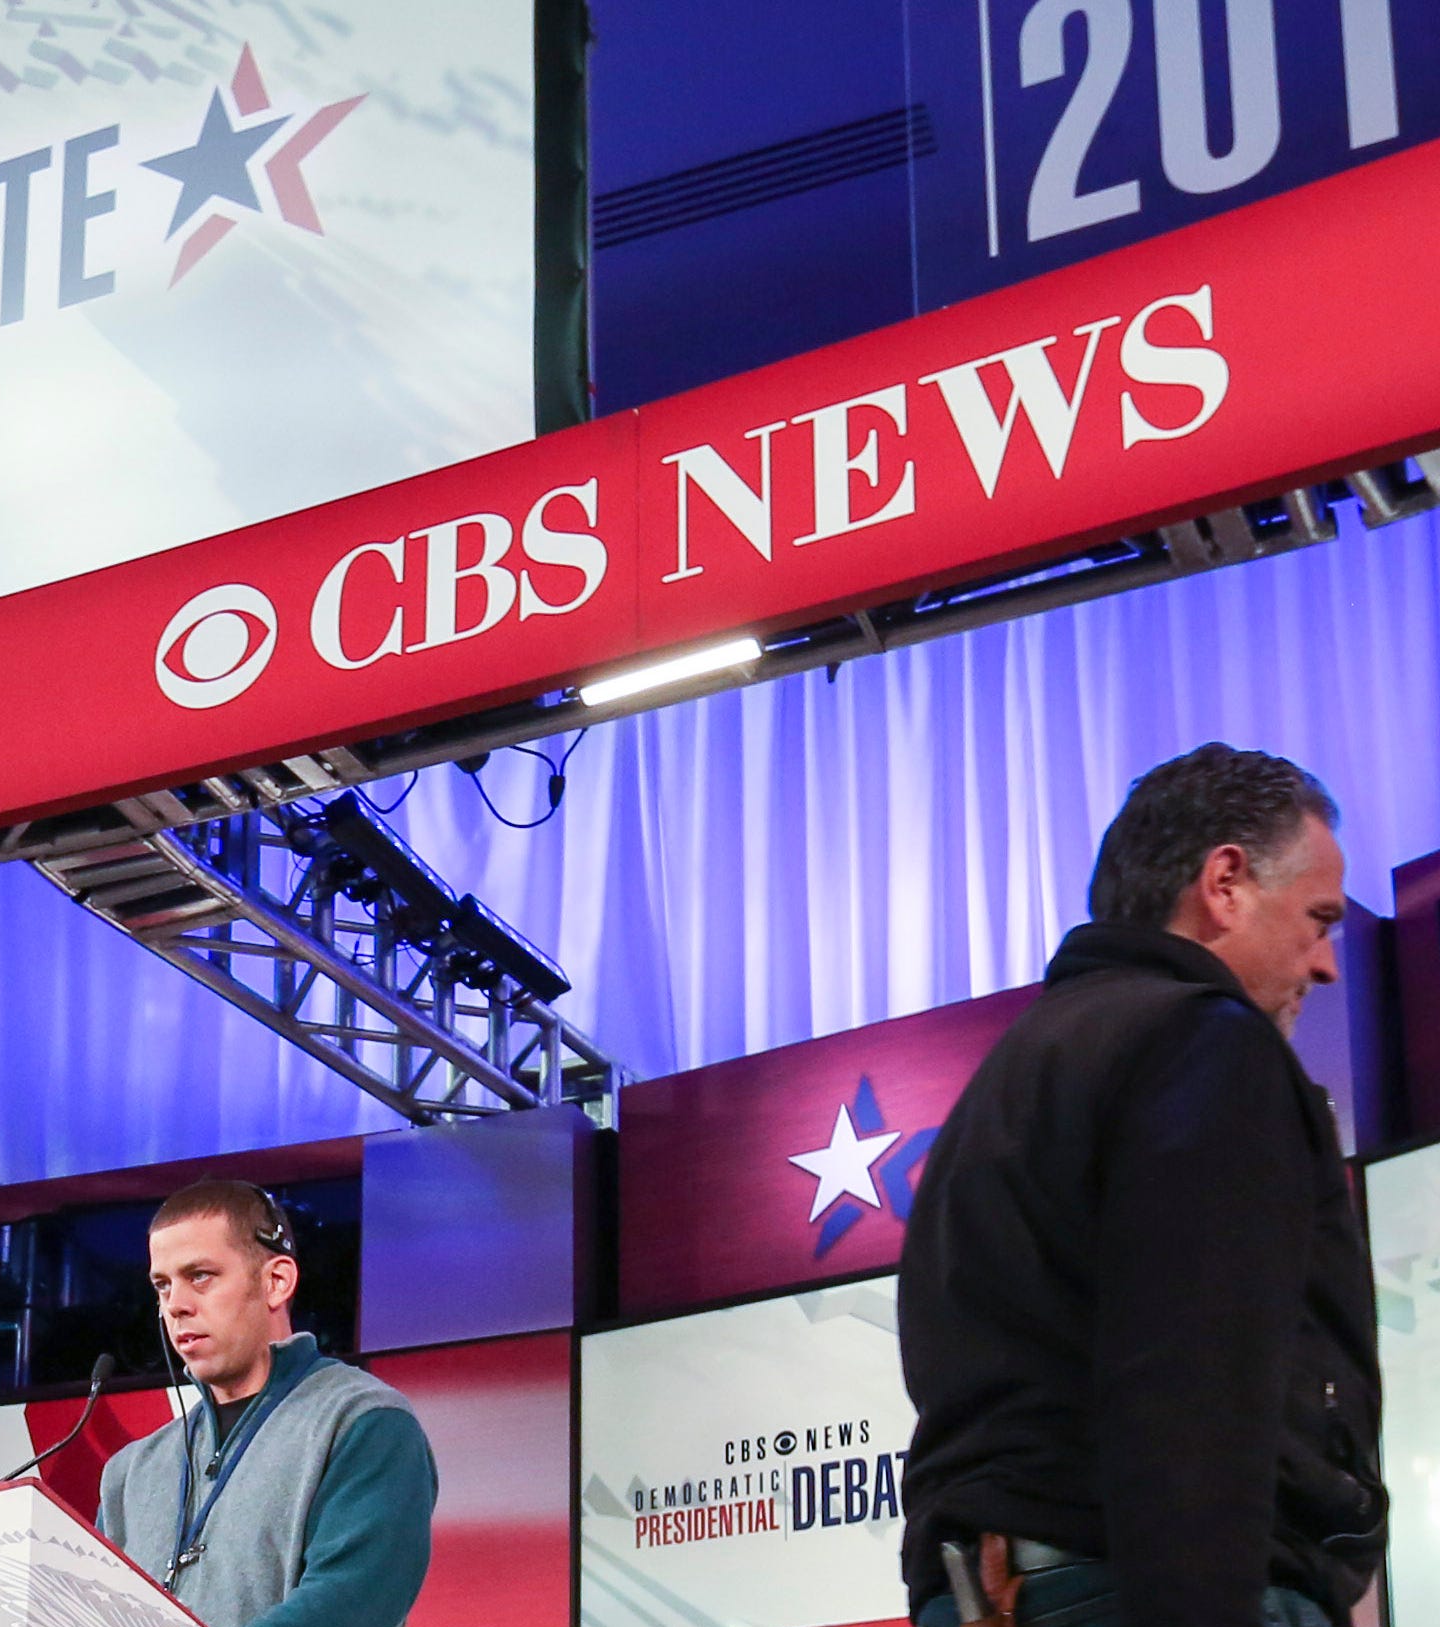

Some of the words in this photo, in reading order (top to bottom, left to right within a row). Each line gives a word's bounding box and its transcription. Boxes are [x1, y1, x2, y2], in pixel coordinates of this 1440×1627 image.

[310, 476, 609, 671] CBS
[661, 283, 1231, 585] NEWS
[725, 1437, 766, 1465] CBS
[806, 1420, 870, 1452] NEWS
[635, 1469, 780, 1511] DEMOCRATIC
[792, 1450, 910, 1531] DEBA
[635, 1497, 780, 1549] PRESIDENTIAL
